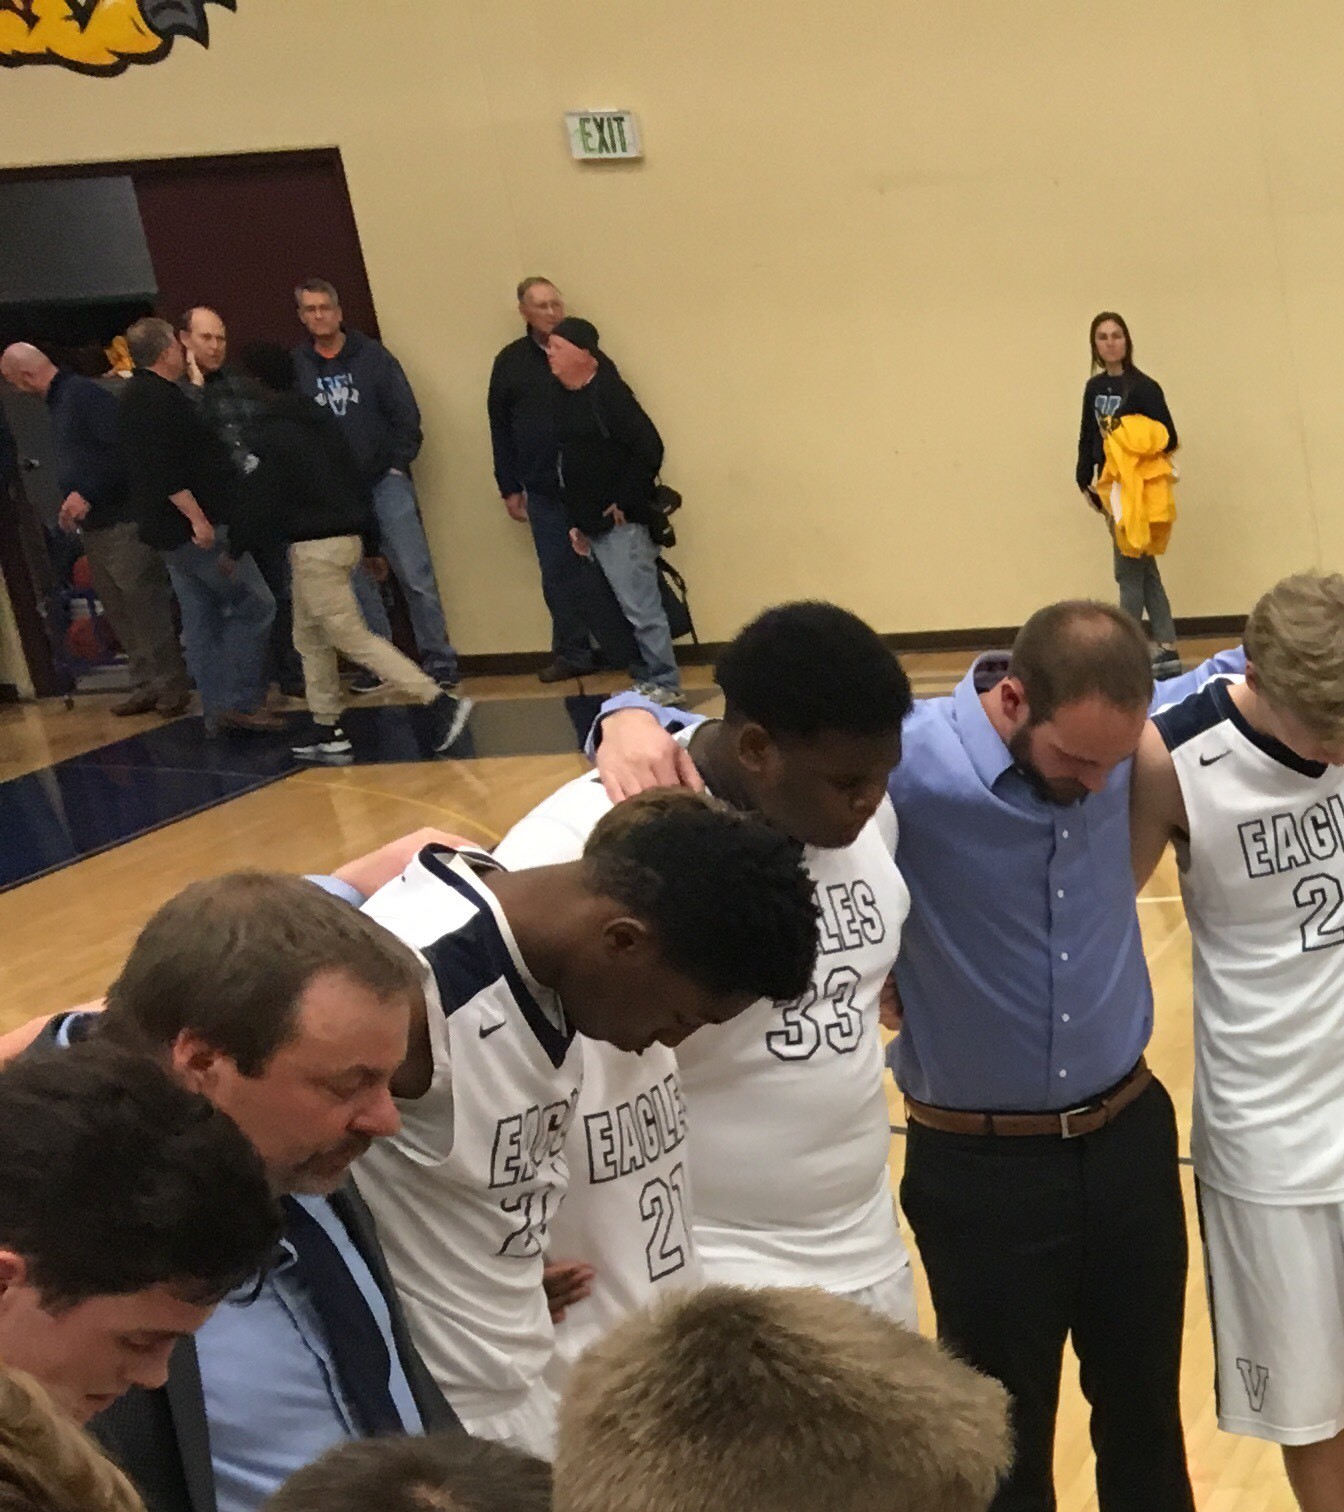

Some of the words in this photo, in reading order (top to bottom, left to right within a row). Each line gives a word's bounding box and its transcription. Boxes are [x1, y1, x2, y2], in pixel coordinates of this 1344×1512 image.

[579, 116, 627, 154] EXIT
[766, 965, 864, 1061] 33
[1236, 1357, 1269, 1412] V
